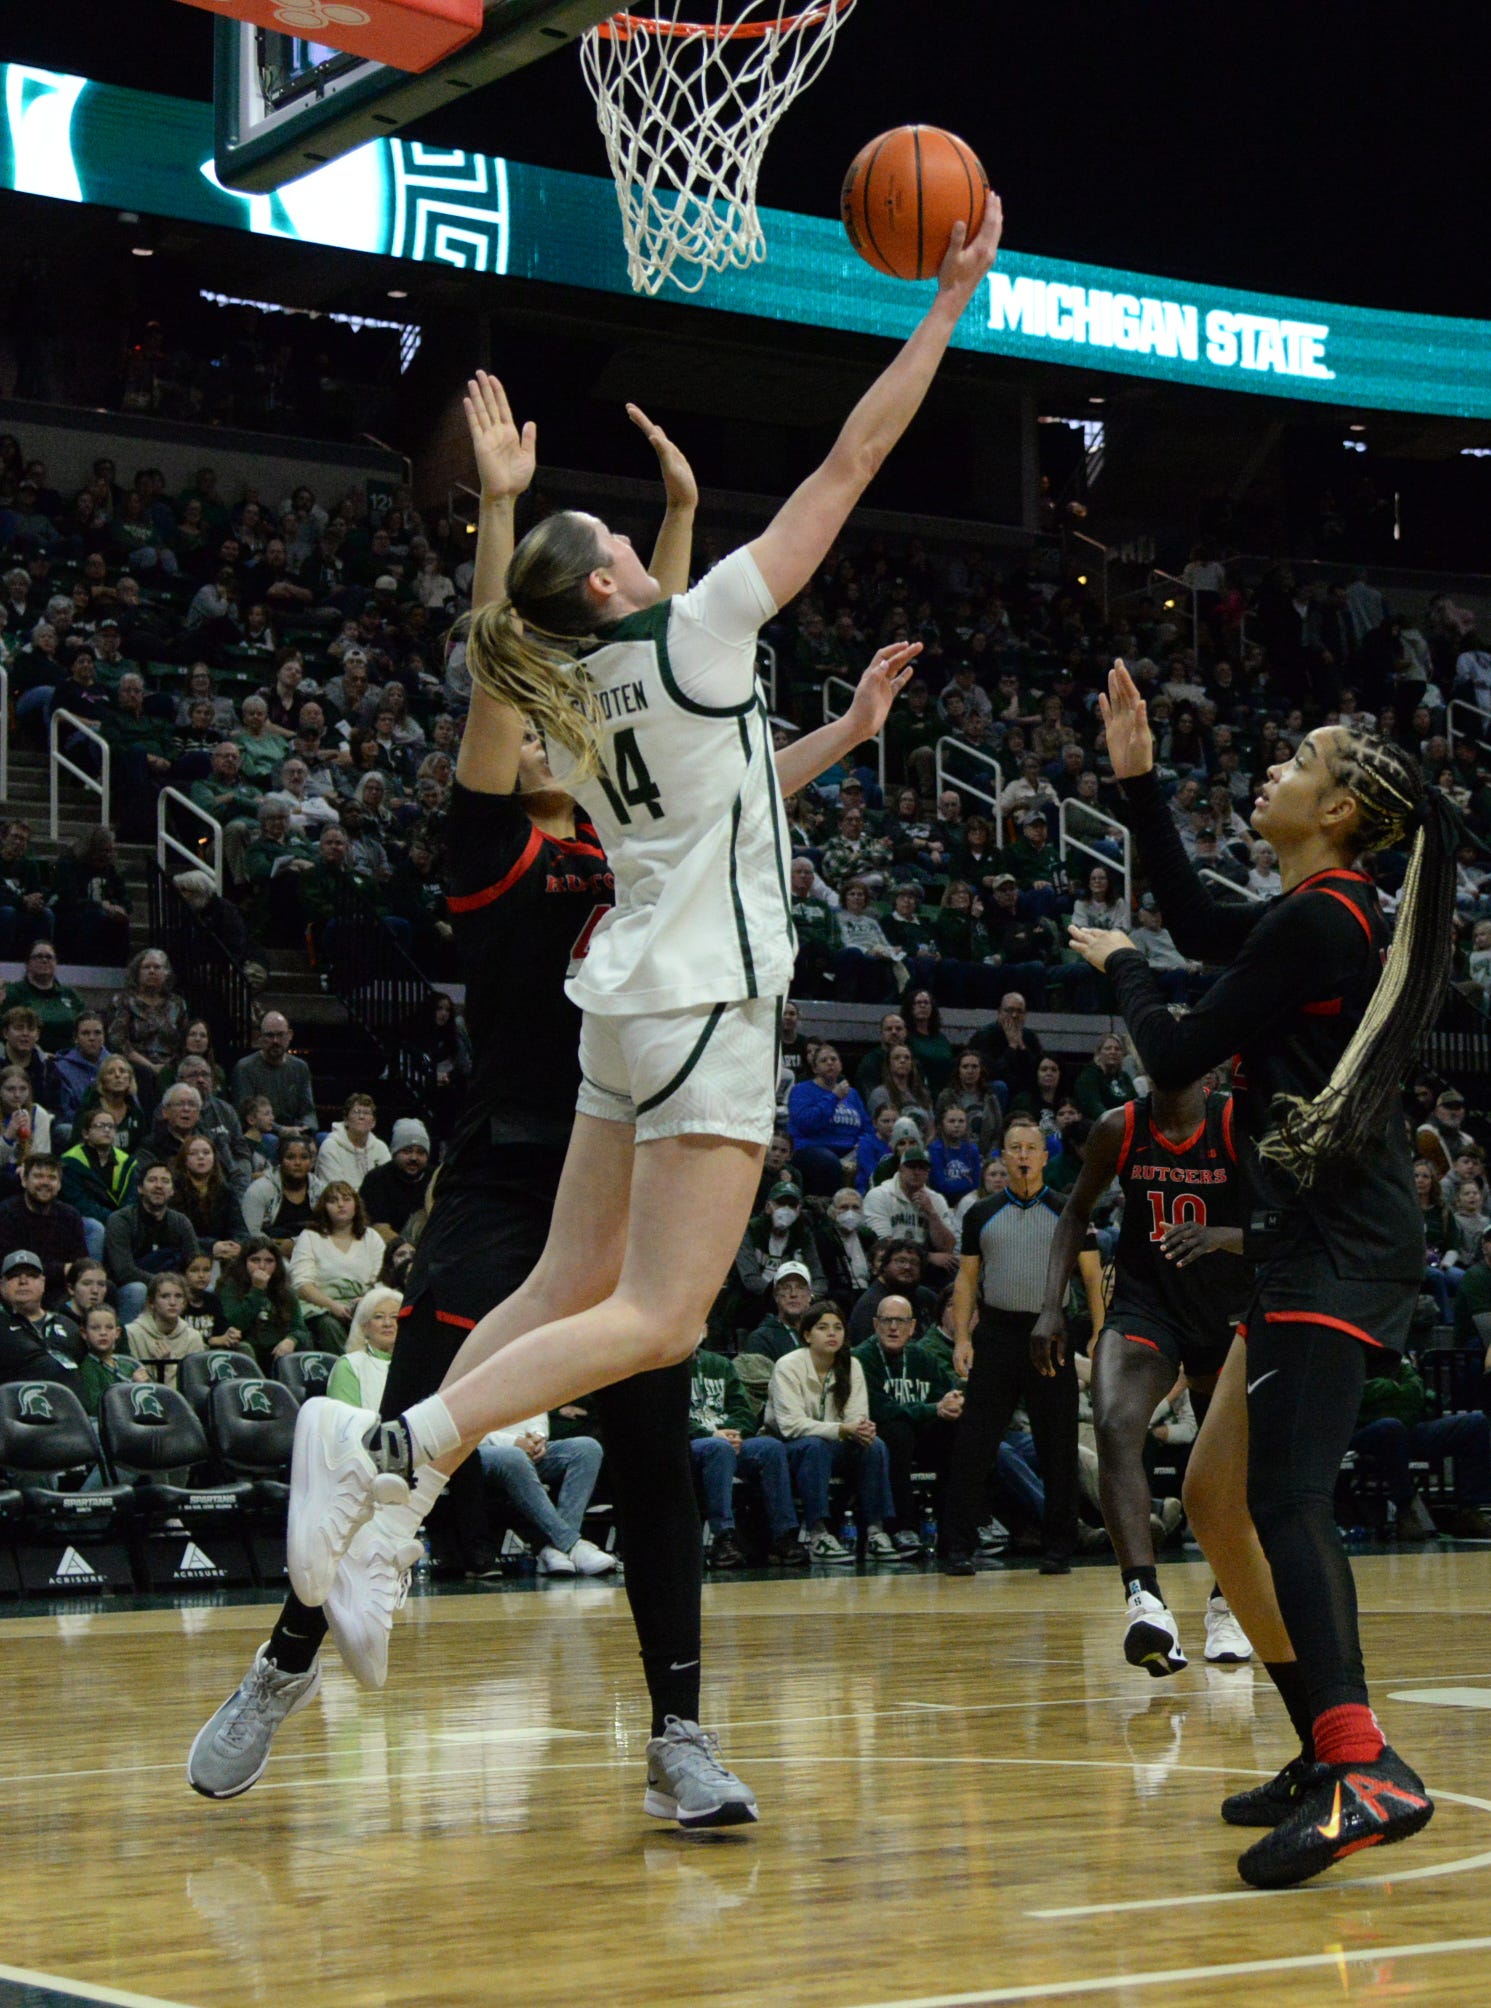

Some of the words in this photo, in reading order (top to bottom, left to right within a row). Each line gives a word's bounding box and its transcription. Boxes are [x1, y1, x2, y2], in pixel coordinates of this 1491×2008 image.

[987, 271, 1198, 361] MICHIGAN
[1205, 309, 1334, 380] STATE
[591, 727, 665, 825] 14
[1130, 1165, 1228, 1184] RUTGERS
[1146, 1190, 1207, 1242] 10
[63, 1497, 114, 1508] SPARTANS
[189, 1494, 237, 1505] SPARTANS
[48, 1575, 104, 1585] ACRISURE
[172, 1569, 225, 1579] ACRISURE
